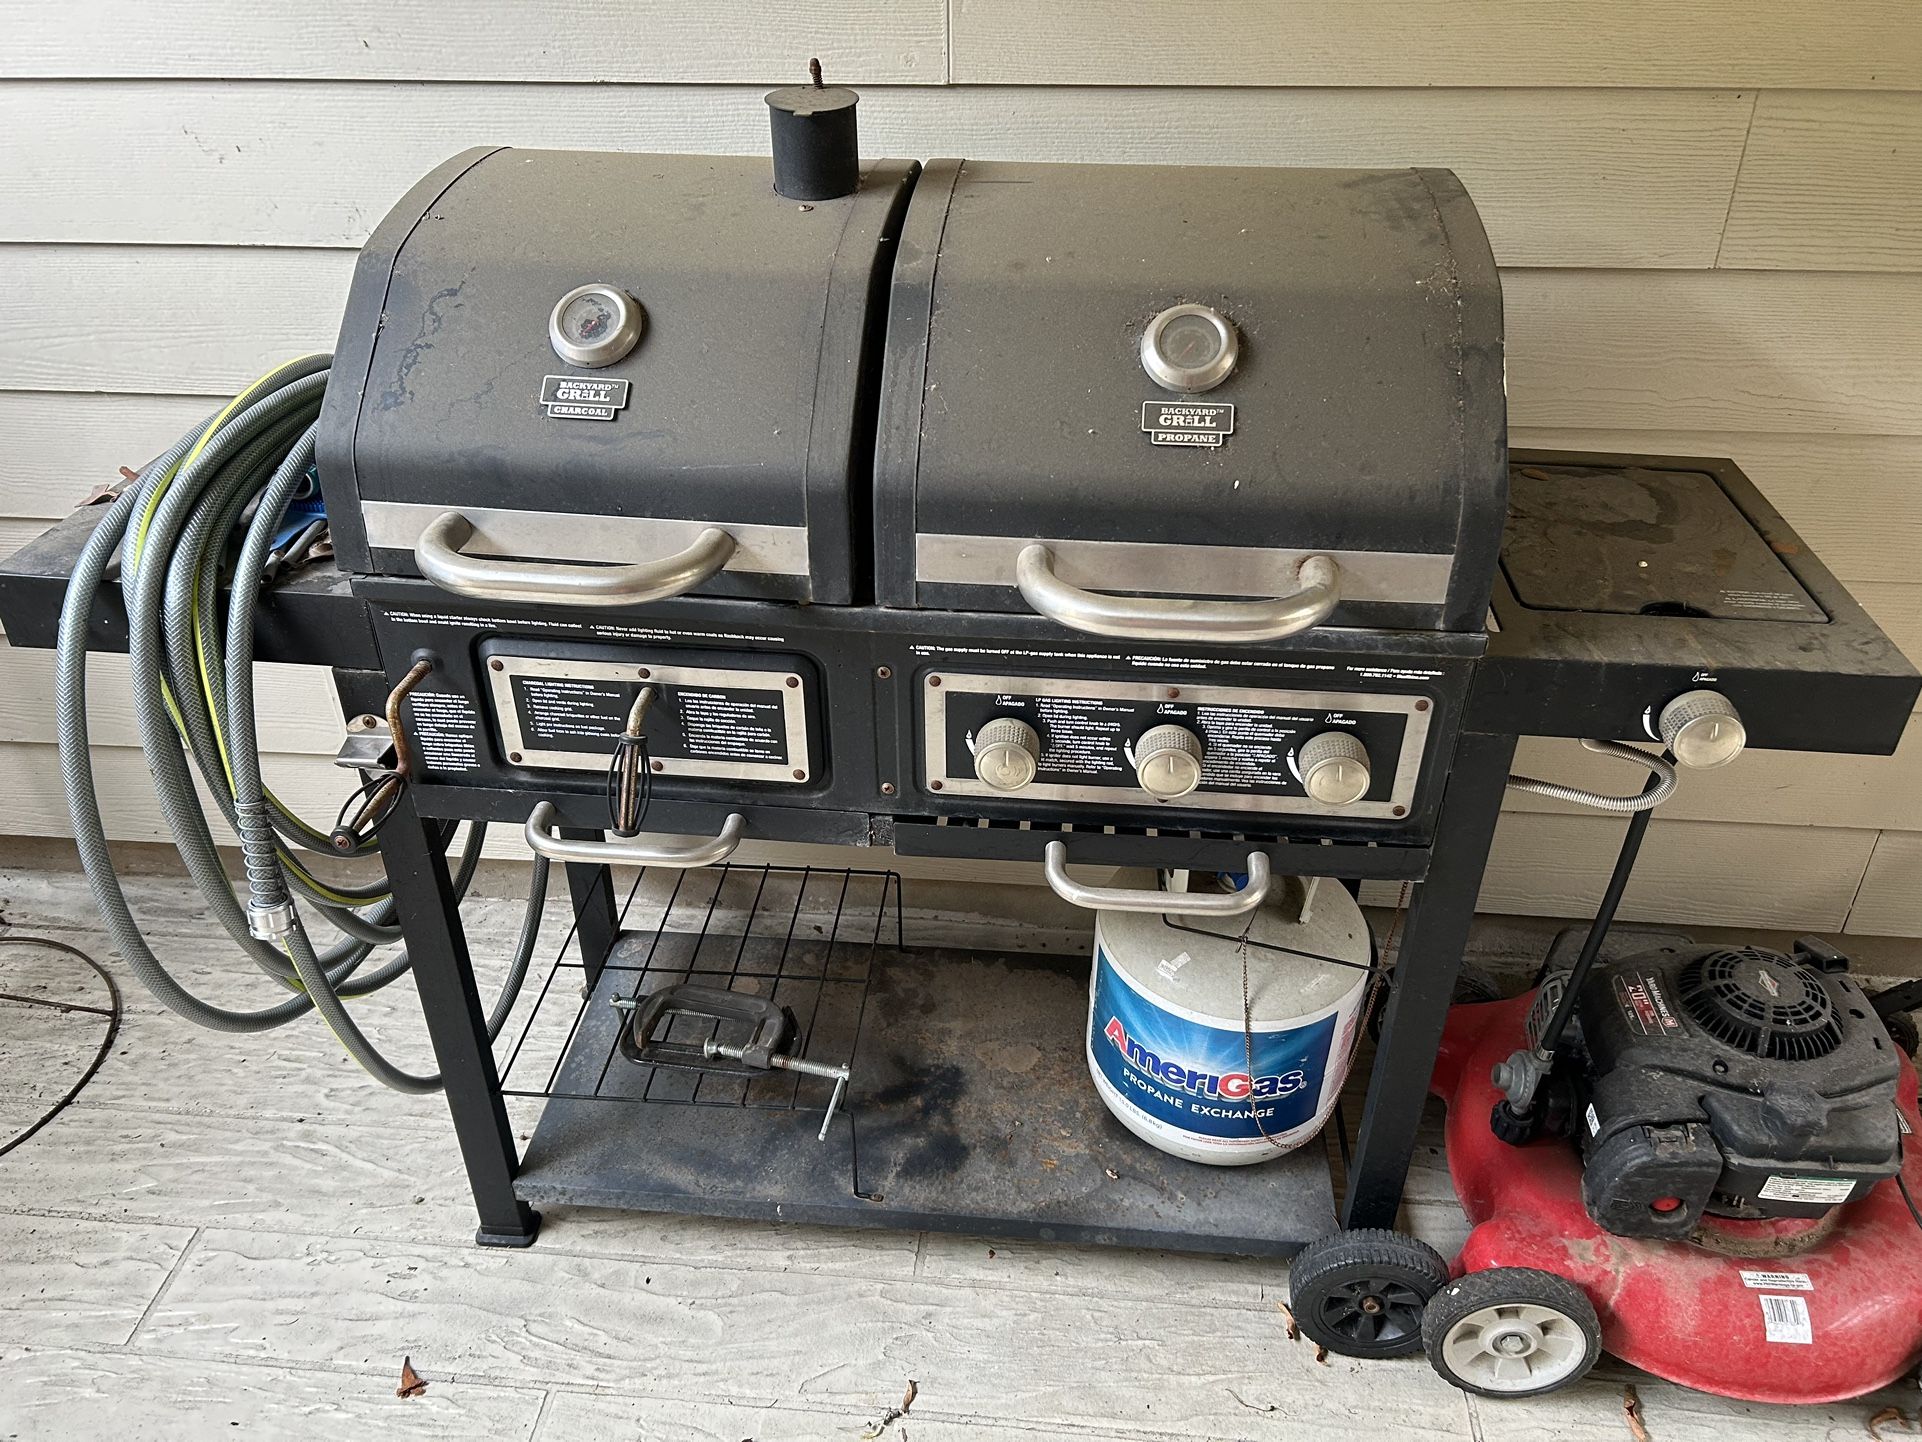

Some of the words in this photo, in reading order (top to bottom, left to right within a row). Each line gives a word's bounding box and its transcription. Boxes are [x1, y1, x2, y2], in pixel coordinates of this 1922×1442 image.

[560, 381, 612, 391] BACKYARD
[556, 388, 610, 402] GRILL
[554, 406, 608, 416] CHARCOAL
[1161, 407, 1216, 416] BACKYARD
[1159, 415, 1216, 427] GRILL
[1157, 433, 1216, 443] PROPANE
[1104, 1016, 1303, 1098] AmeriGas
[1124, 1068, 1183, 1108] PROPANE
[1191, 1104, 1275, 1120] EXCHANGE
